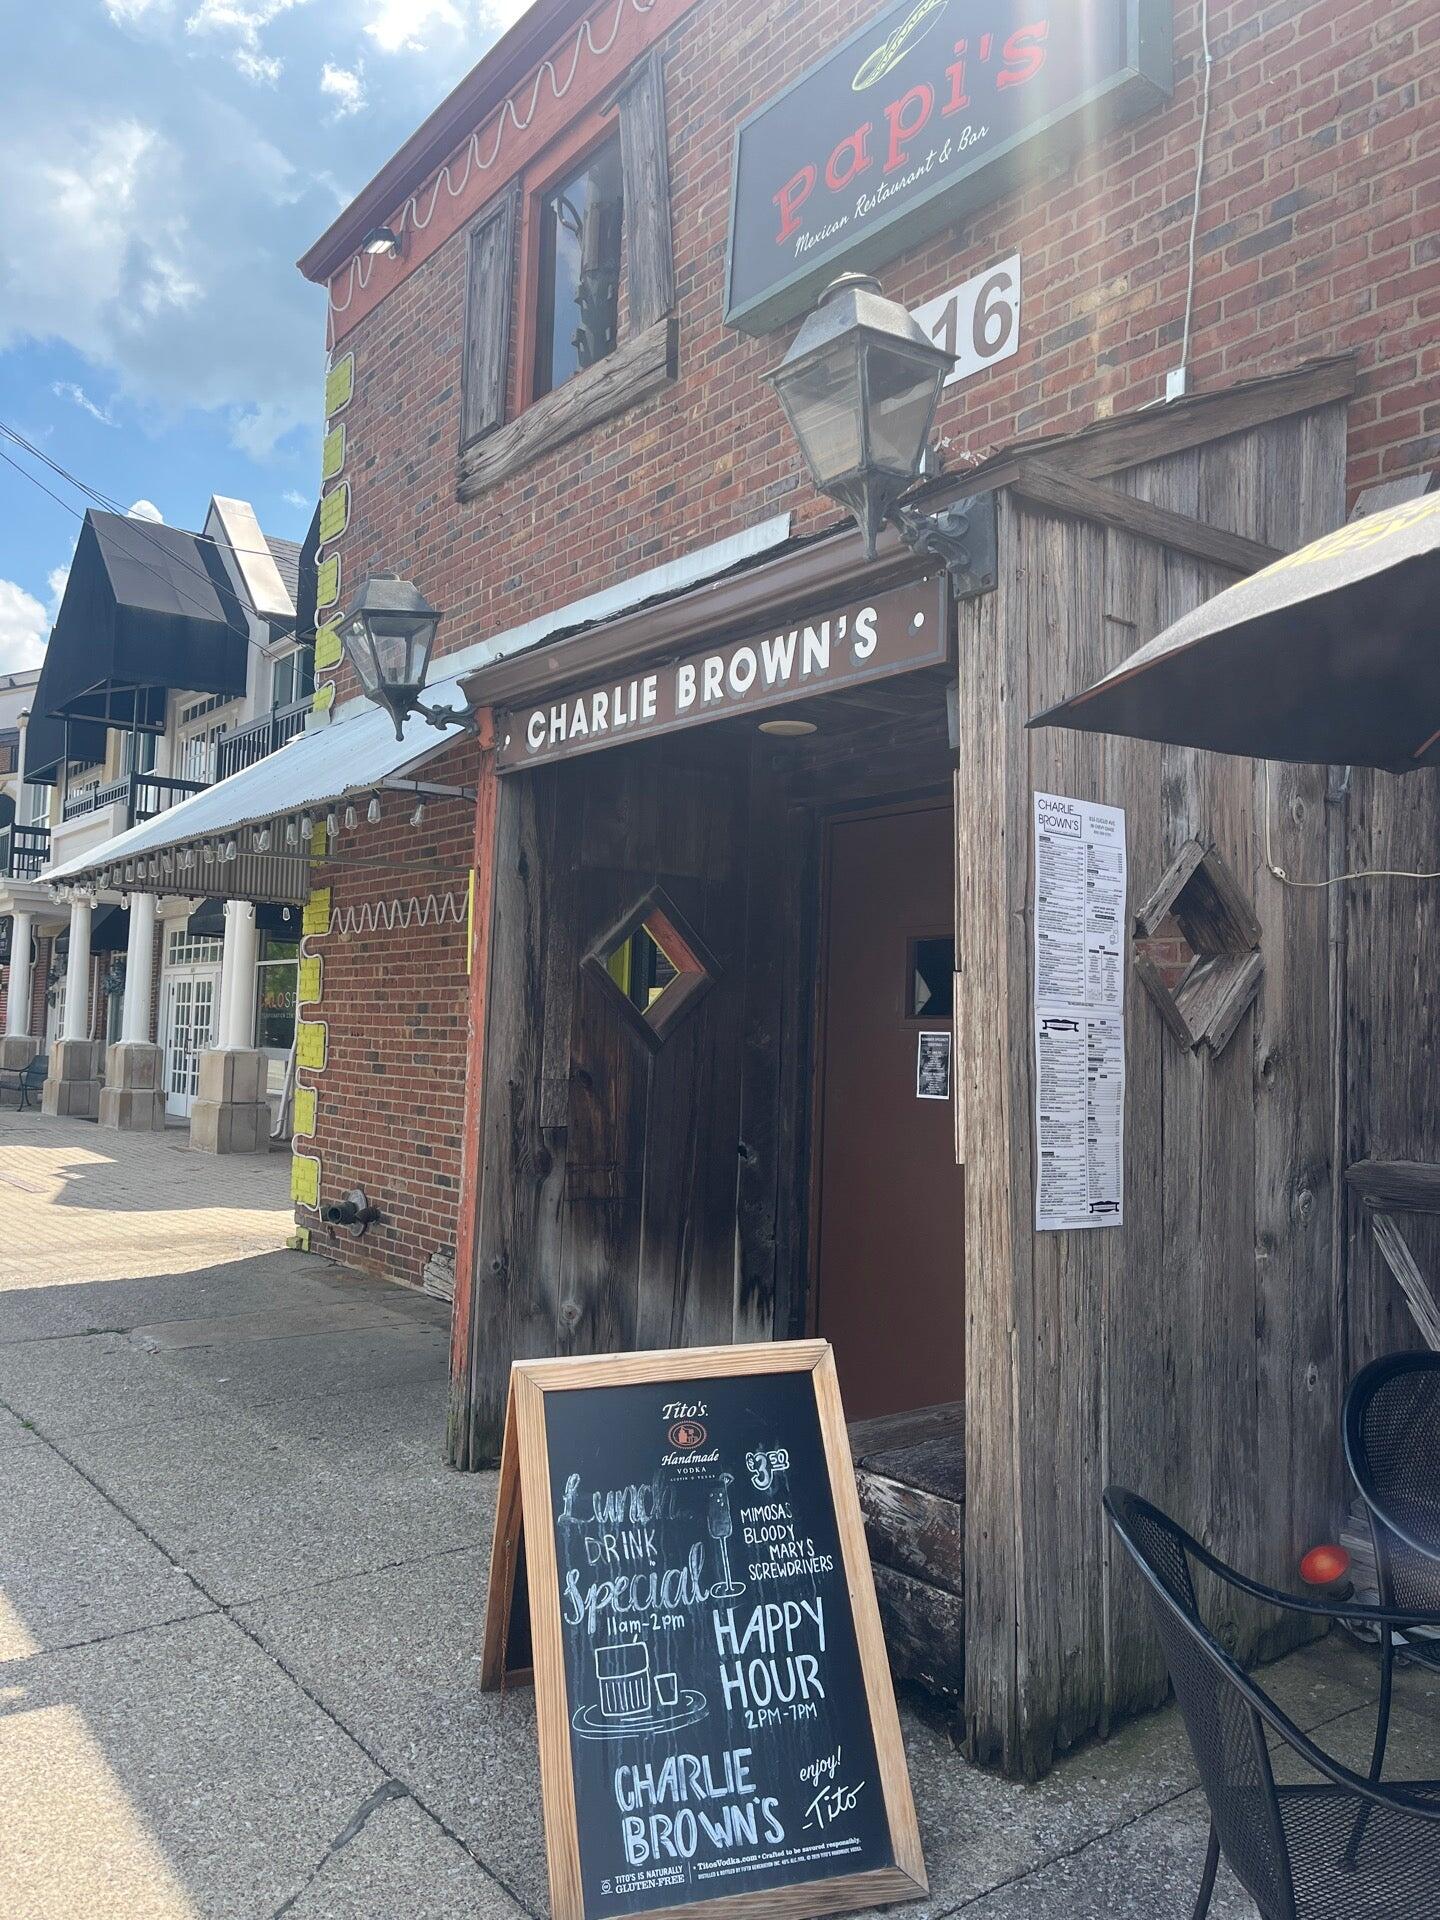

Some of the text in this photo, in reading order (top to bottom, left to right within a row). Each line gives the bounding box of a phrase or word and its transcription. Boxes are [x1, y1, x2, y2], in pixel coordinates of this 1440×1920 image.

[794, 125, 989, 258] Mexican Restaurant & Bar
[527, 607, 878, 748] CHARLIE BROWN'S
[1038, 799, 1074, 815] CHARLIE
[1038, 814, 1079, 831] BROWN'S
[661, 1448, 720, 1466] Handmade
[677, 1466, 707, 1475] VODKA
[741, 1502, 793, 1523] MIMOSAS
[585, 1528, 658, 1566] DRINK
[744, 1524, 795, 1544] BLOODY
[748, 1554, 834, 1581] SCREWDRIVERS
[564, 1541, 709, 1634] Special
[712, 1597, 826, 1655] HAPPY
[720, 1655, 825, 1711] HOUR
[800, 1745, 841, 1788] enjoy!
[614, 1748, 757, 1813] CHARLIE
[622, 1797, 786, 1866] BROWN'S
[697, 1854, 758, 1871] TitosVodka.com
[762, 1850, 784, 1860] Crafted
[615, 1865, 683, 1884] TITO'S IS NATURALLY
[615, 1874, 685, 1894] GLUTEN-FREE
